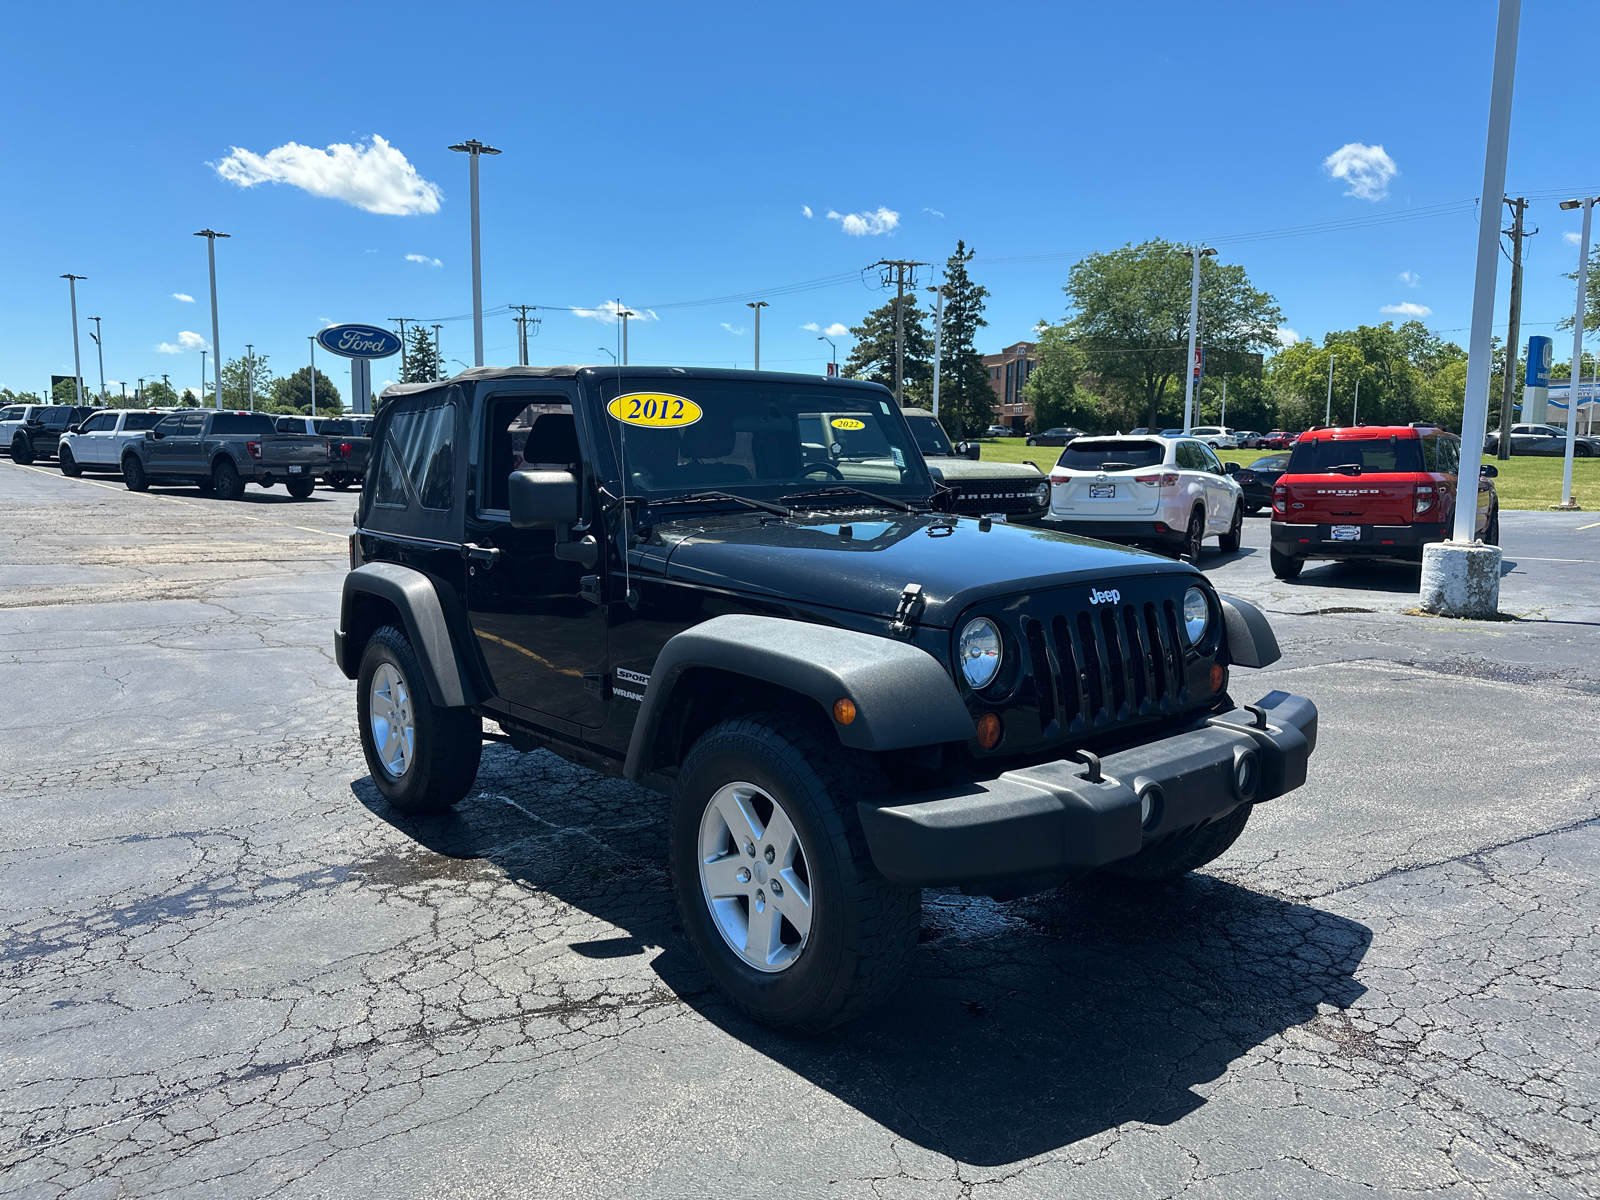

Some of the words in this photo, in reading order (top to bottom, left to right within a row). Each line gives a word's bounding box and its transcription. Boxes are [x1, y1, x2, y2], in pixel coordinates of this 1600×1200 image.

[338, 330, 386, 352] Ford
[627, 398, 685, 420] 2012
[1089, 588, 1121, 605] Jeep
